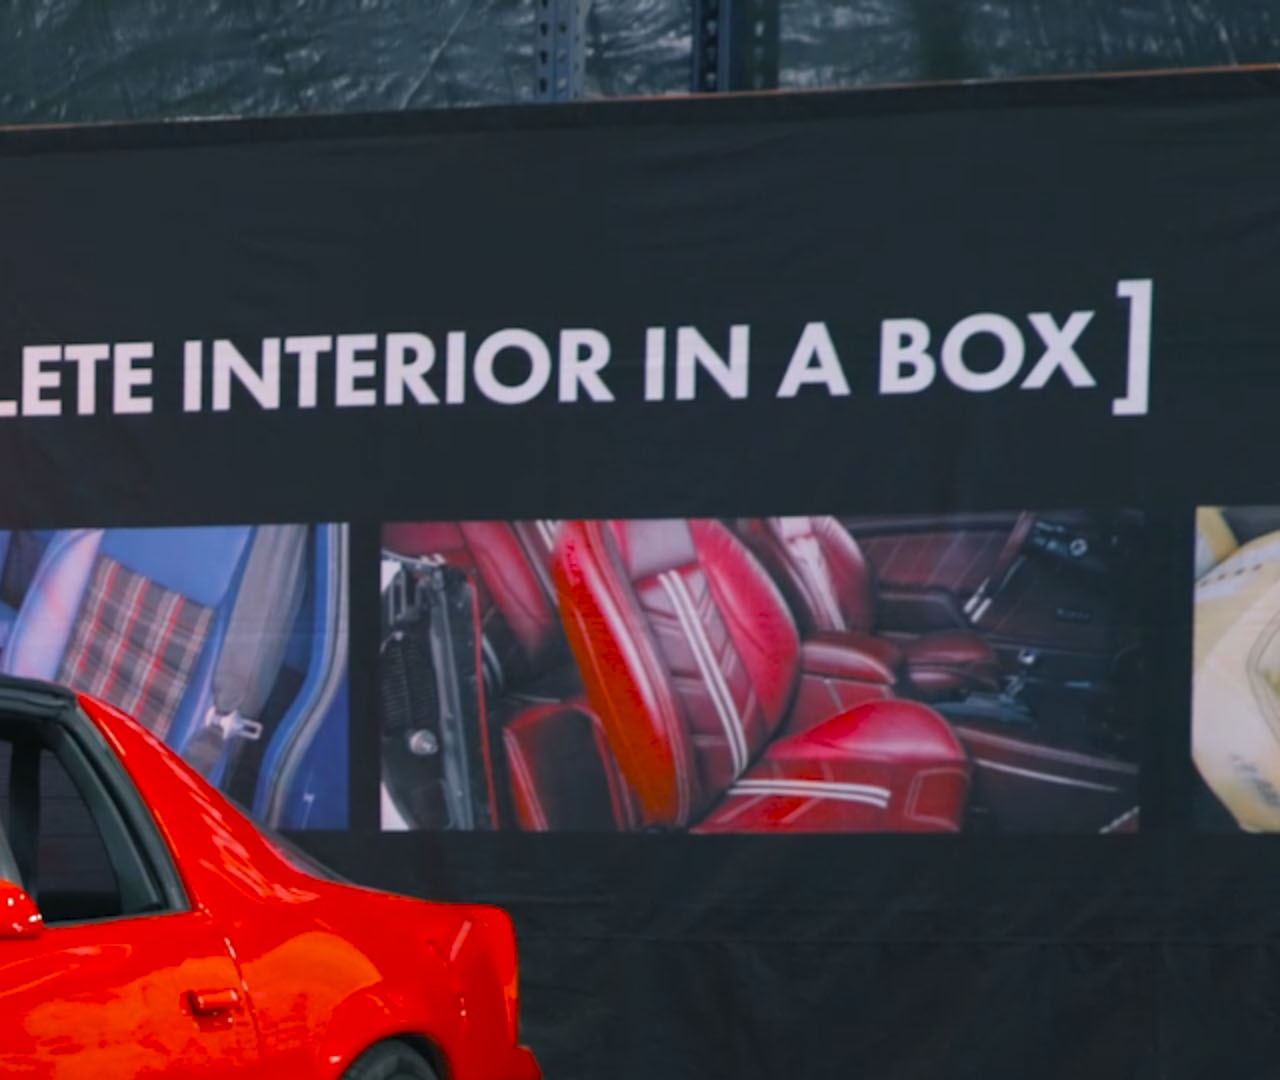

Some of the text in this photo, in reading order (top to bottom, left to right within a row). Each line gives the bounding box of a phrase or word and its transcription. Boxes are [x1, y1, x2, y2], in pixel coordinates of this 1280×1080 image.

[184, 329, 614, 412] INTERIOR
[645, 325, 749, 400] IN
[777, 322, 850, 397] A
